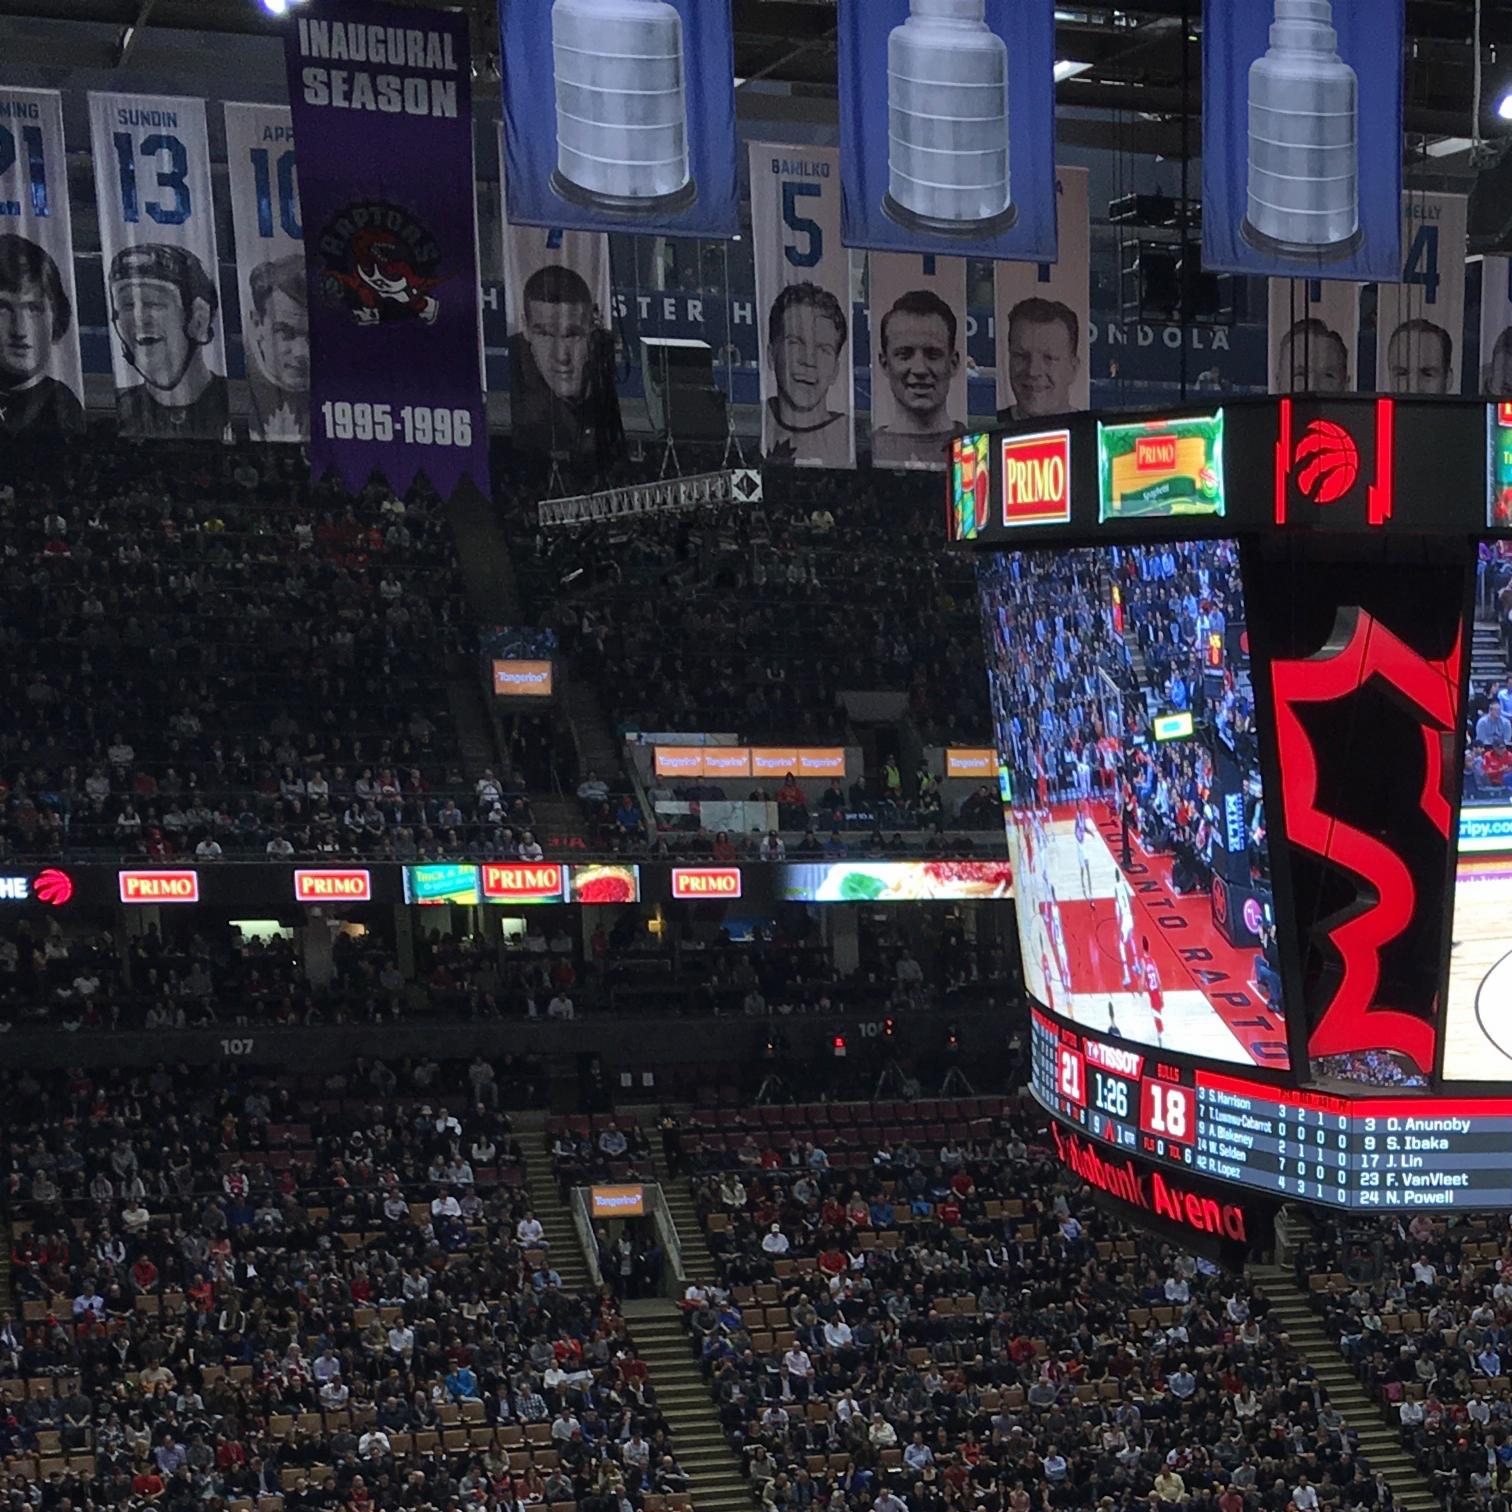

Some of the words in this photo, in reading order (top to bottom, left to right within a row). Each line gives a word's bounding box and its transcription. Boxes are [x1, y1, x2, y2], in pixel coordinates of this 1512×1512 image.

[300, 18, 458, 70] INAUGURAL
[302, 68, 458, 118] SEASON
[118, 109, 178, 128] SUNDIN
[114, 132, 191, 226] 13
[782, 182, 823, 267] 5
[1403, 225, 1441, 304] 4
[322, 401, 472, 447] 1995-1996
[1139, 444, 1175, 465] PRIMO
[1007, 455, 1064, 505] PRIMO
[127, 877, 192, 895] PRIMO
[302, 876, 364, 895] PRIMO
[489, 867, 559, 889] PRIMO
[679, 876, 736, 892] PRIMO
[221, 1039, 253, 1054] 107
[1061, 1050, 1080, 1099] 21
[1095, 1073, 1128, 1117] 1:26
[1151, 1085, 1186, 1137] 18
[1364, 1118, 1376, 1131] 3
[1405, 1117, 1471, 1134] Anunoby
[1364, 1136, 1376, 1150] 9
[1387, 1136, 1401, 1150] S.
[1404, 1136, 1449, 1150] Ibaka
[1361, 1154, 1379, 1168] 17
[1386, 1154, 1398, 1168] J.
[1401, 1153, 1423, 1168] Lin
[1360, 1173, 1379, 1186] 23
[1386, 1173, 1399, 1187] F.
[1402, 1172, 1469, 1187] VanVleet
[1152, 1171, 1247, 1243] Arena
[1360, 1191, 1379, 1204] 24
[1386, 1190, 1401, 1204] N.
[1404, 1189, 1454, 1204] Powell
